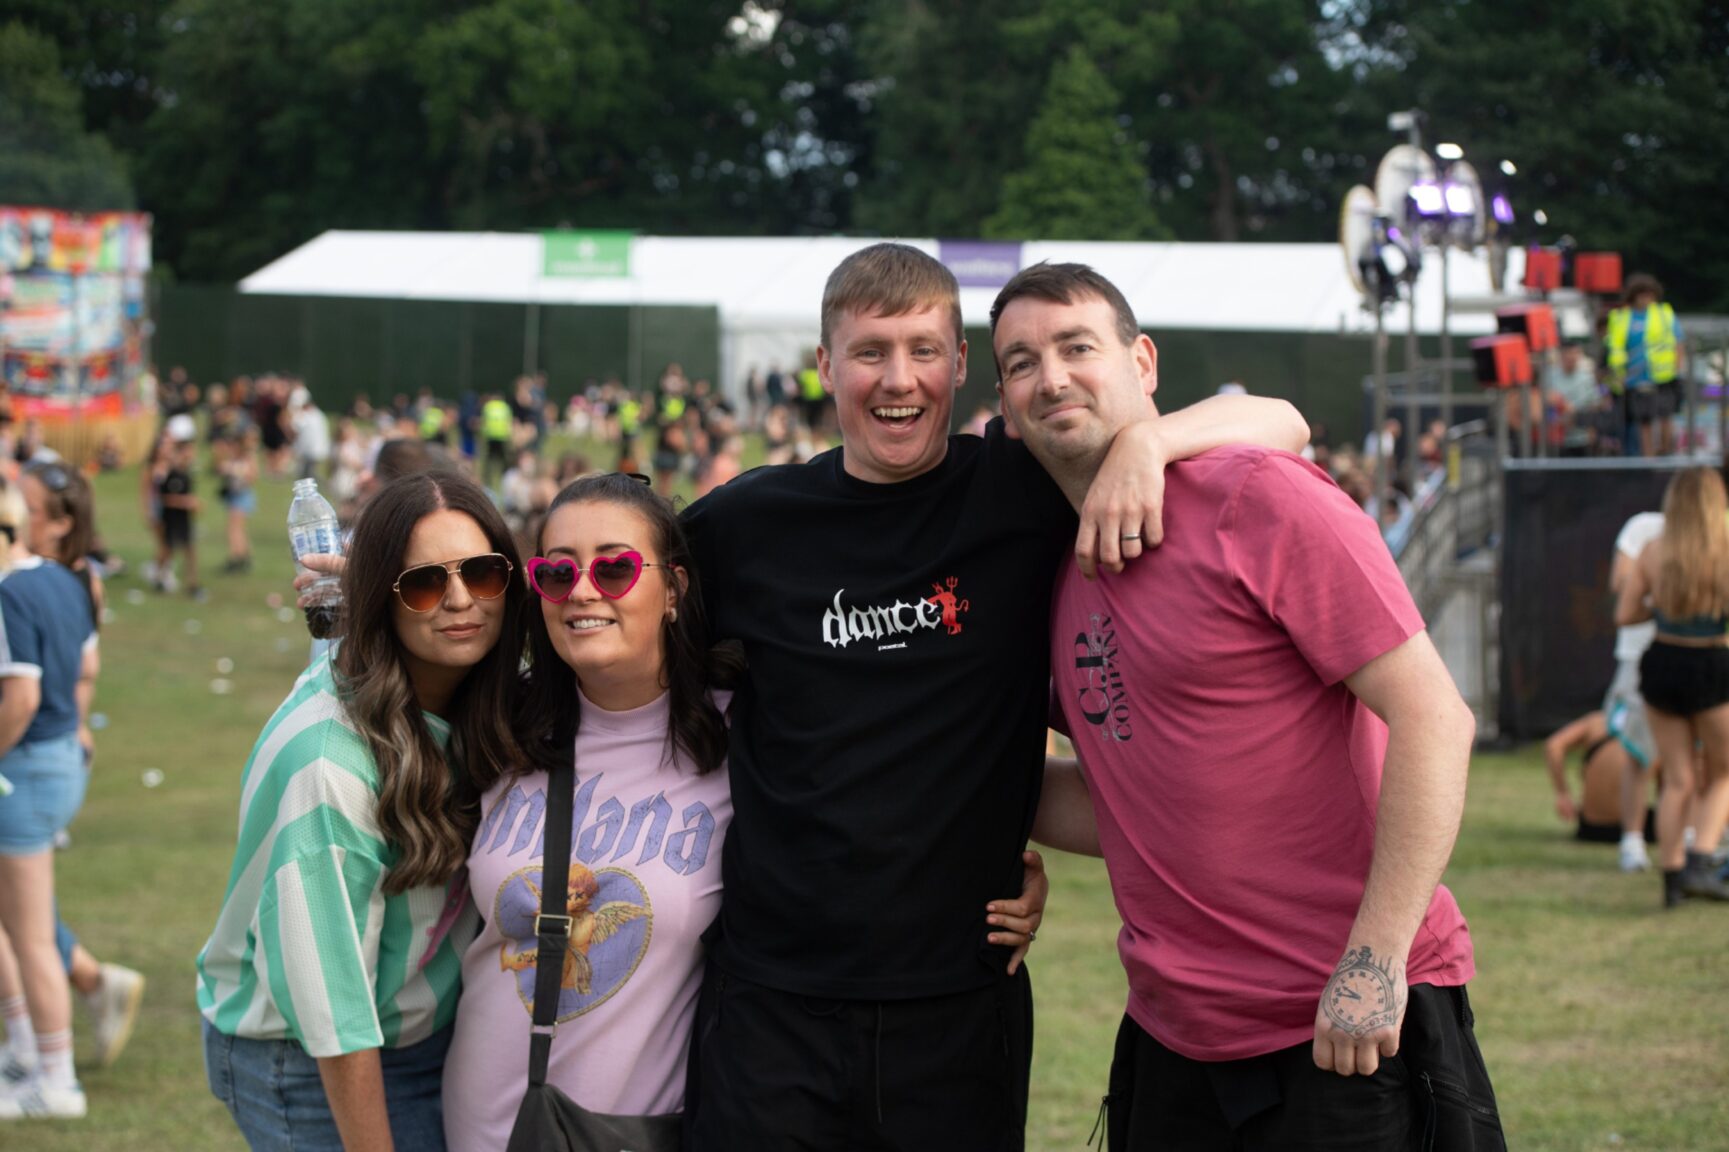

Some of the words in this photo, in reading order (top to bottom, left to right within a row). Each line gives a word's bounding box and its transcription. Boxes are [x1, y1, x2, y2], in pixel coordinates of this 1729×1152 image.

[822, 588, 941, 648] dance
[1101, 615, 1133, 742] COMPANY
[474, 771, 716, 877] mlana
